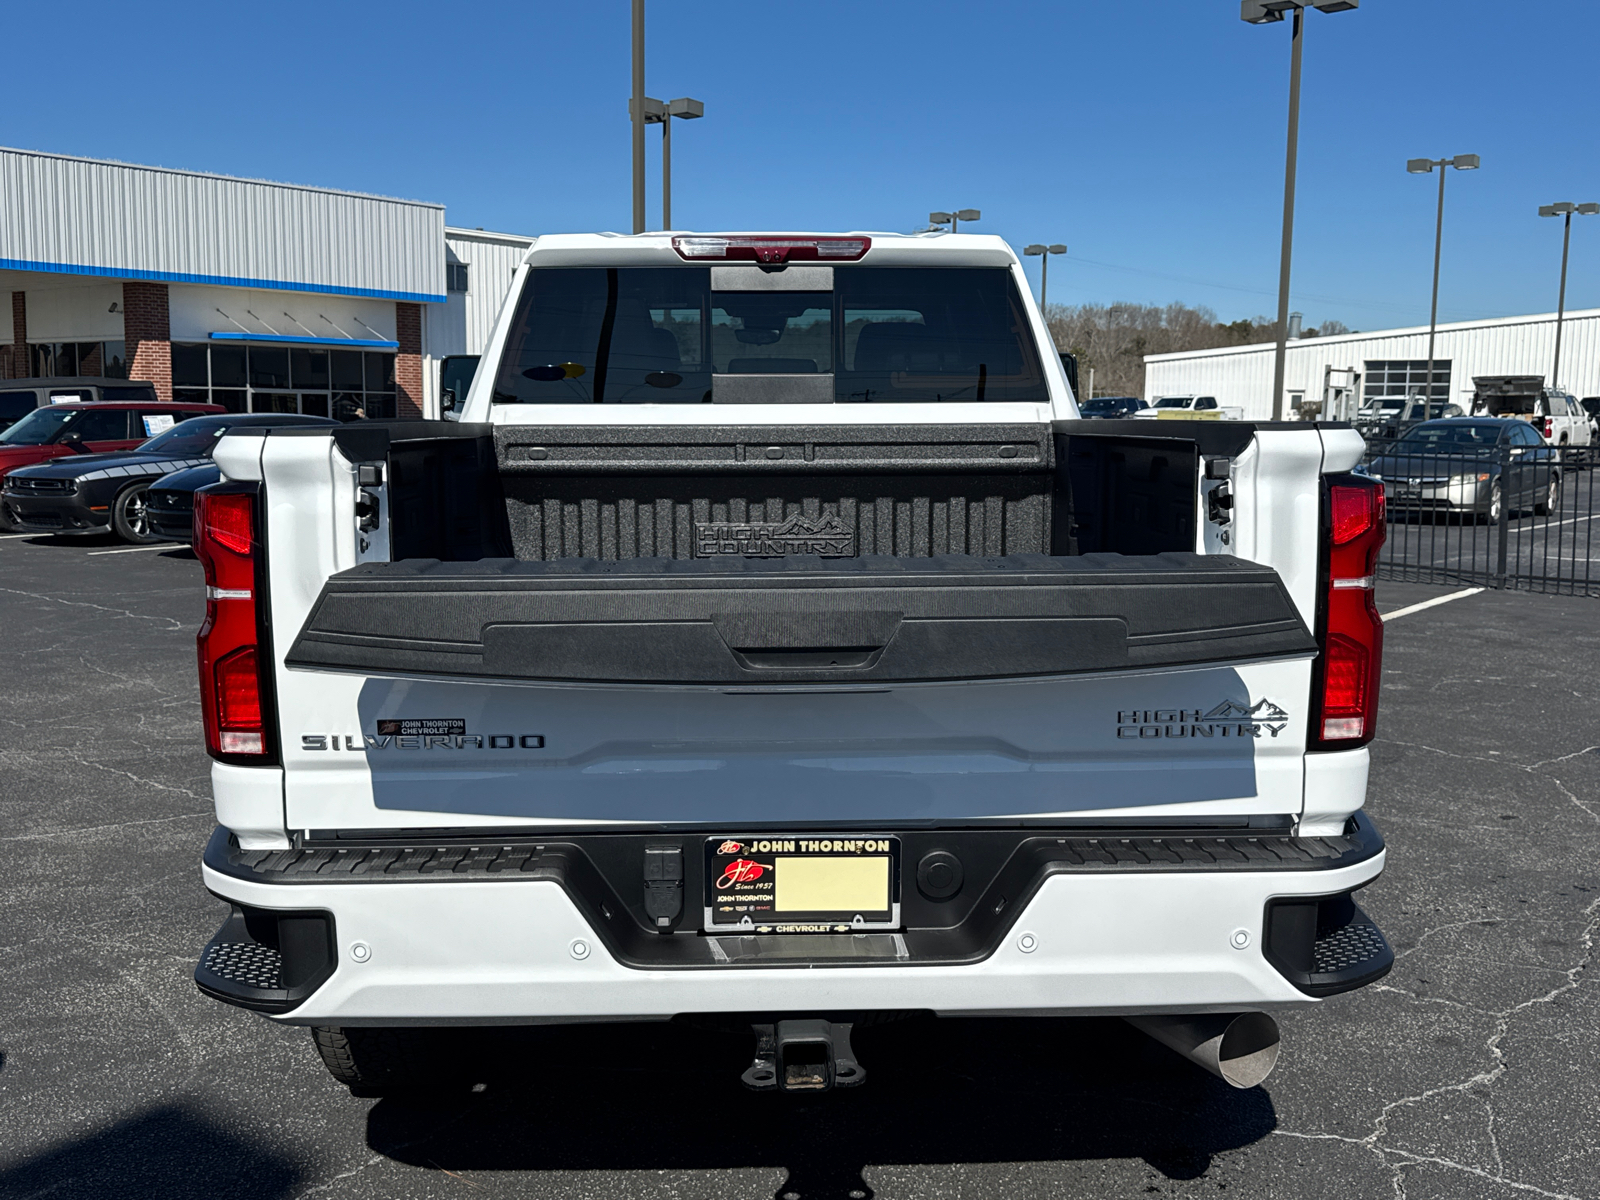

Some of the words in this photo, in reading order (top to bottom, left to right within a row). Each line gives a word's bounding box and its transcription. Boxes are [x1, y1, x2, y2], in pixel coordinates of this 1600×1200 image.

[699, 526, 775, 540] HIGH
[698, 540, 851, 555] COUNTRY
[1117, 709, 1203, 723] HIGH
[401, 720, 421, 728] JOHN
[422, 720, 464, 728] THORNTON
[401, 727, 449, 735] CHEVROLET
[1117, 723, 1288, 739] COUNTRY
[301, 734, 546, 751] SILVERADO
[750, 840, 796, 853] JOHN
[755, 882, 773, 890] 1957
[735, 894, 773, 902] THORNTON
[776, 925, 831, 933] CHEVROLET
